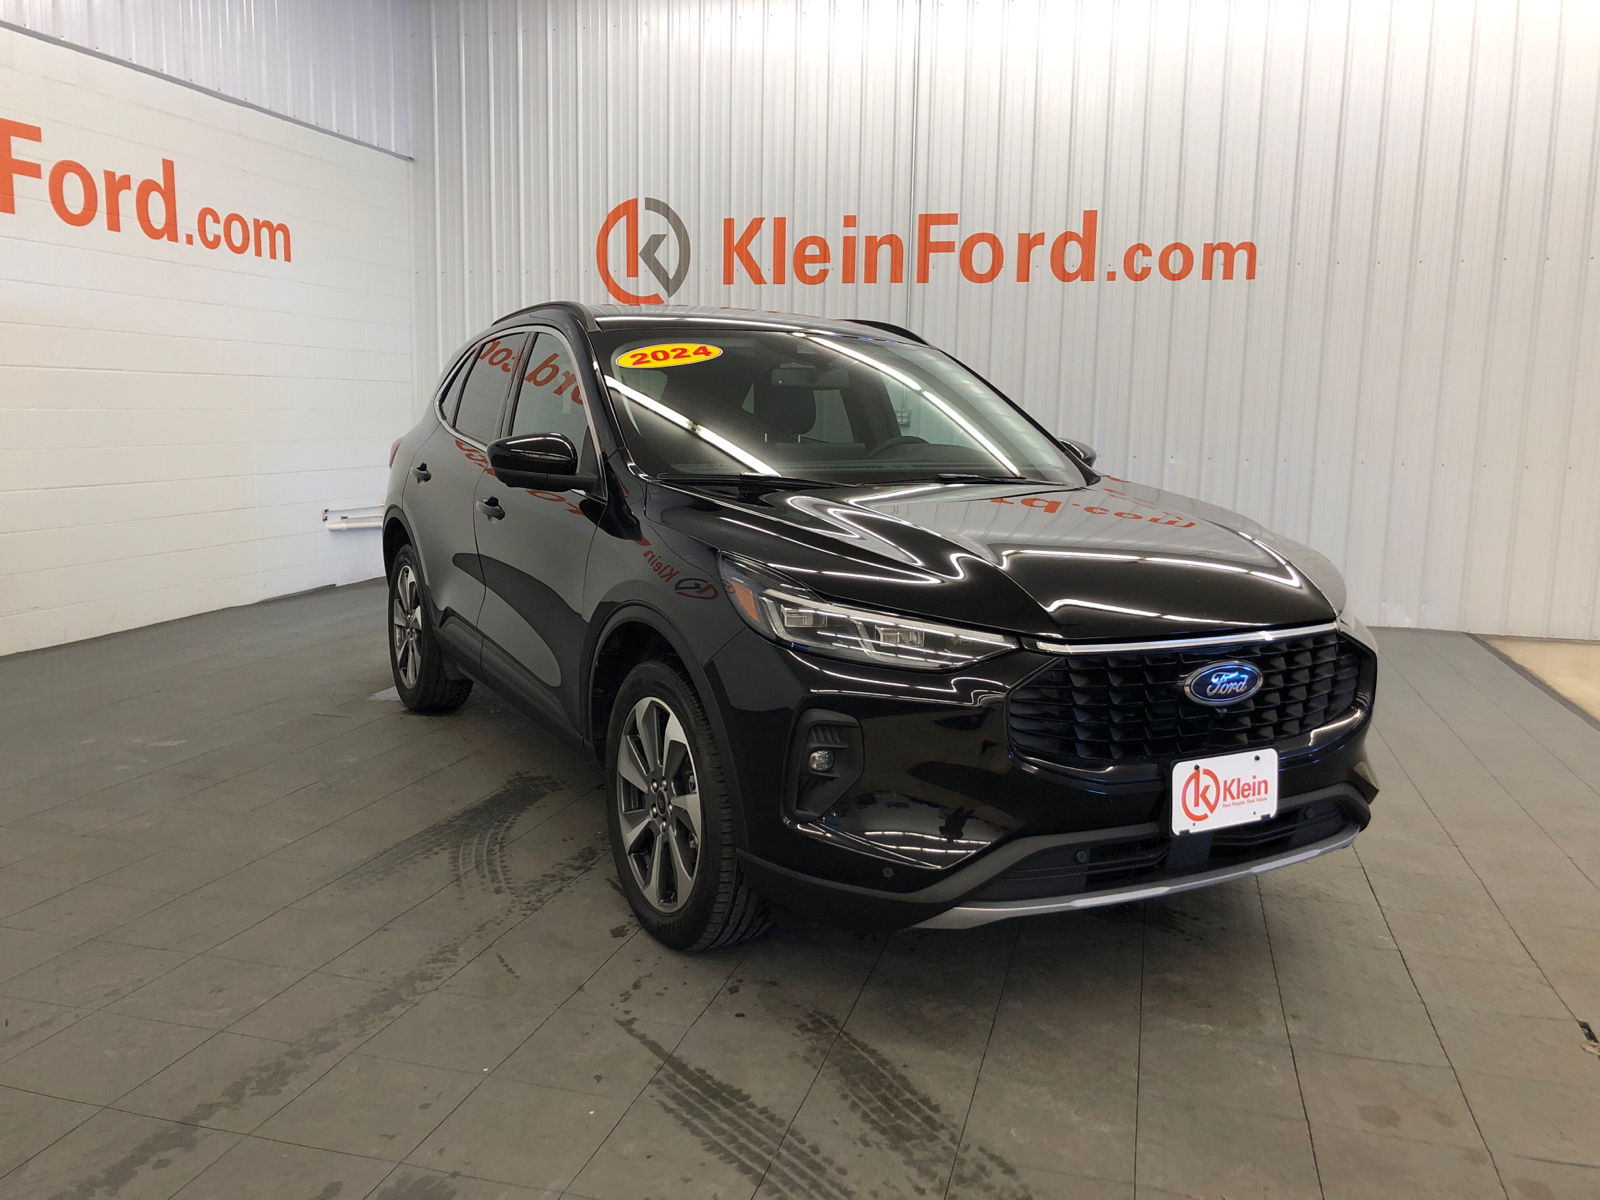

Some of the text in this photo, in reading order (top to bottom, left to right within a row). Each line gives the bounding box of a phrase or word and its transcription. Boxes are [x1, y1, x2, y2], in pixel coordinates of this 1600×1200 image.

[0, 118, 292, 262] Ford.com
[723, 210, 1257, 286] KleinFord.com
[629, 345, 712, 366] 2024
[1206, 671, 1249, 696] Ford
[1223, 775, 1268, 802] Klein
